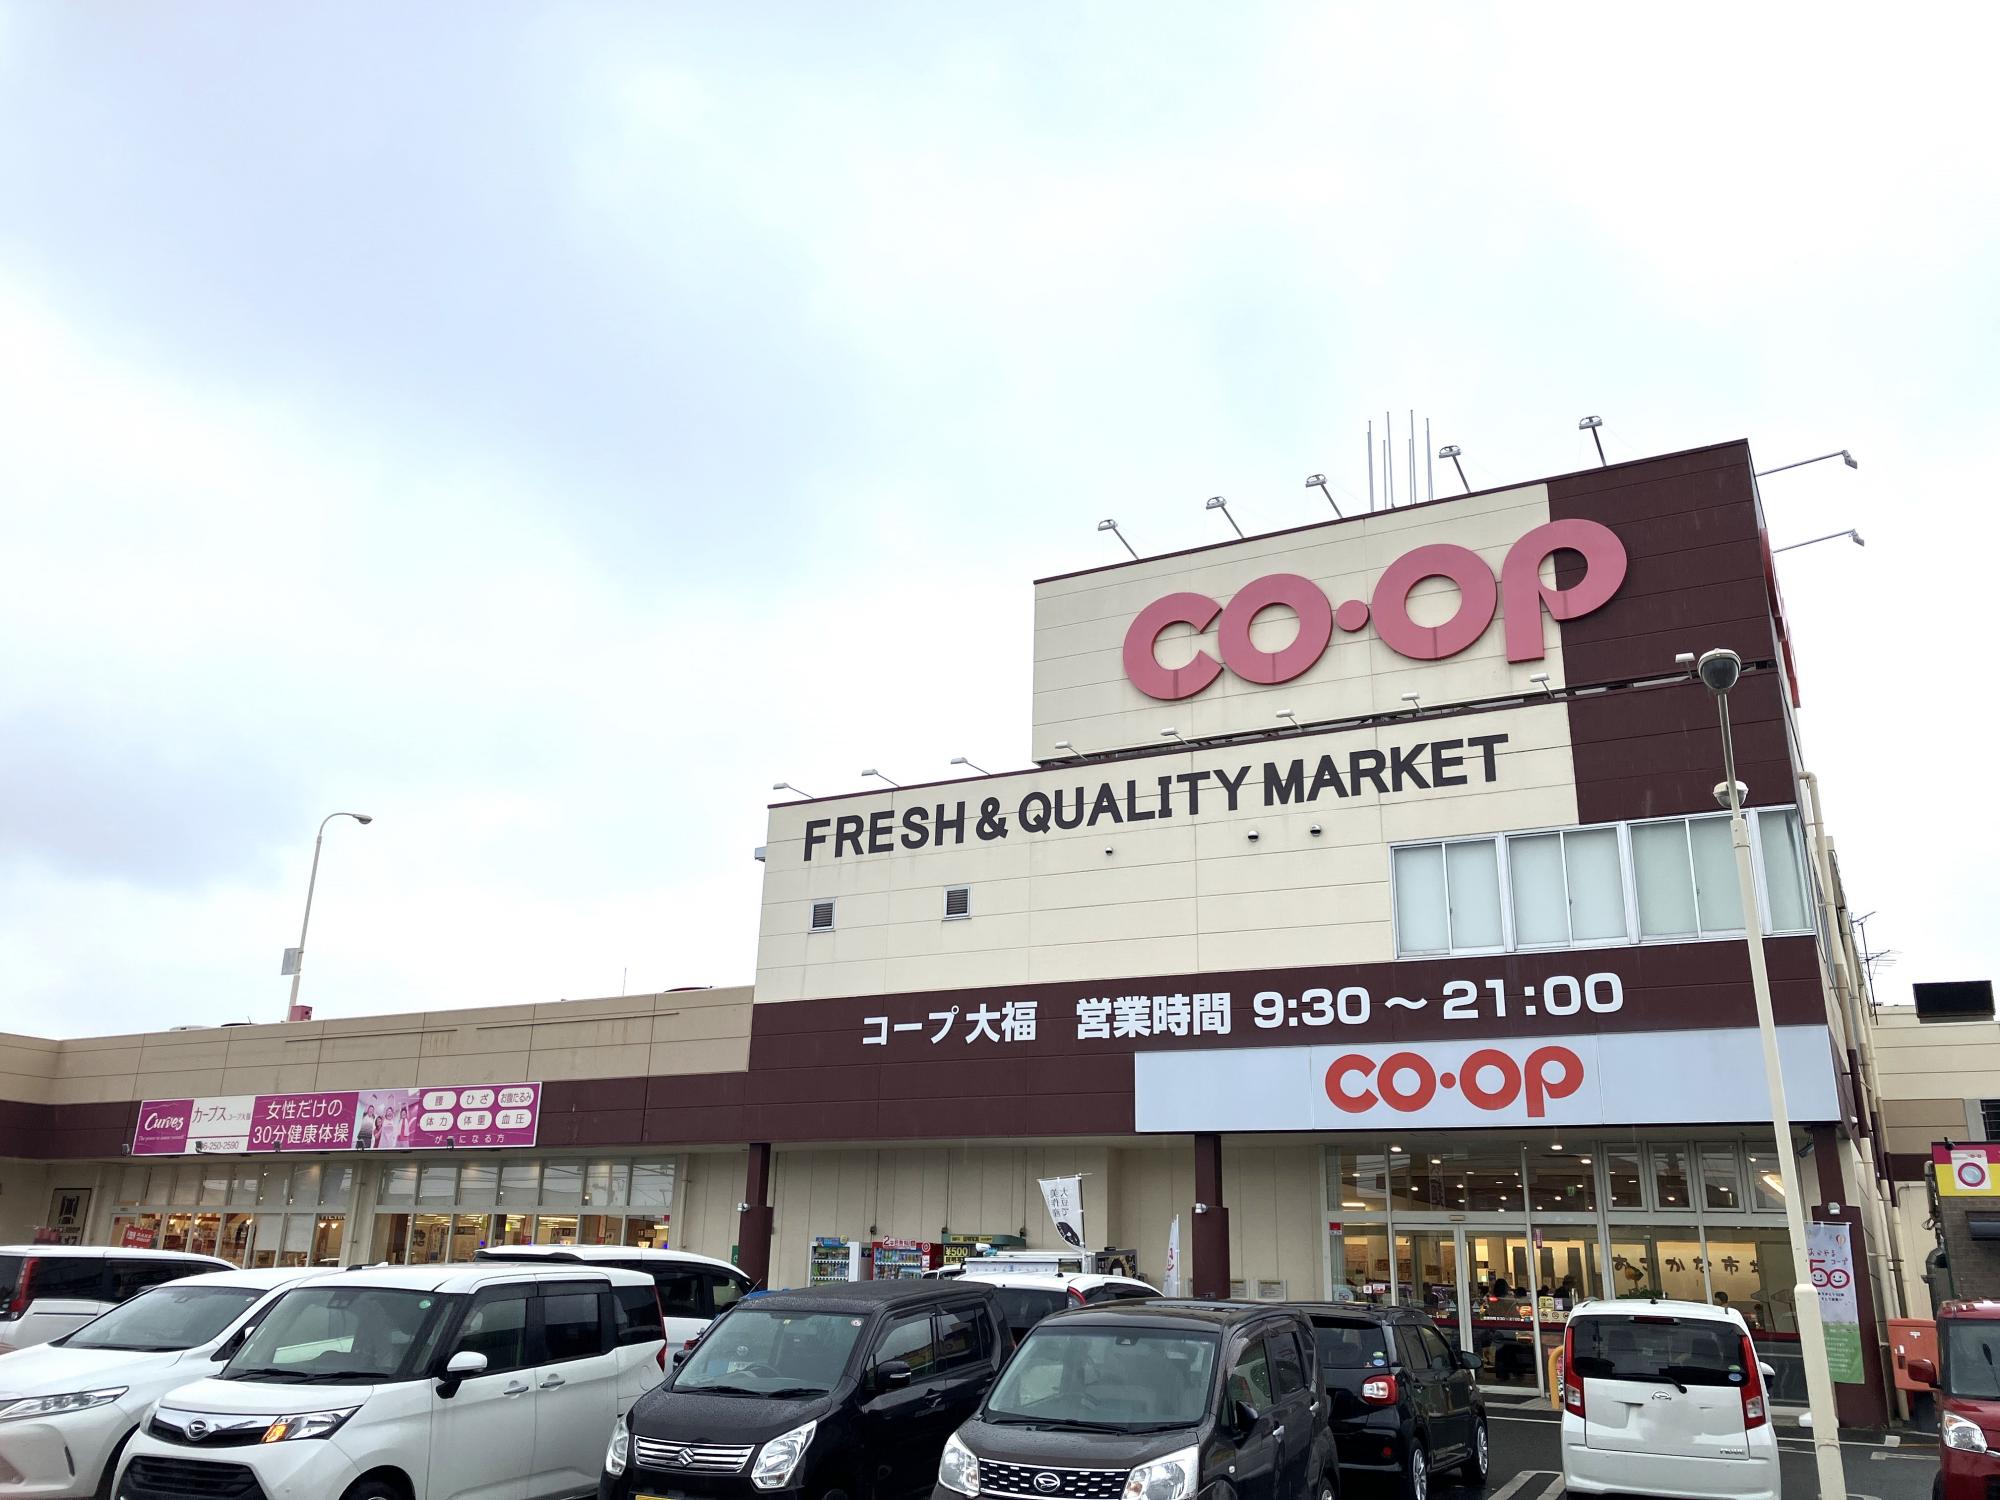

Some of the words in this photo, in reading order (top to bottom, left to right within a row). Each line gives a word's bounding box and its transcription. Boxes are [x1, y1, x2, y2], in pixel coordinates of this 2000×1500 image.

[803, 799, 966, 861] FRESH
[976, 796, 1009, 840] &
[1017, 765, 1252, 835] QUALITY
[1262, 733, 1509, 807] MARKET
[862, 1001, 1037, 1046] コープ大福
[1076, 992, 1232, 1040] 営業時間
[1252, 985, 1371, 1029] 9:30
[1442, 972, 1625, 1021] 21:00
[466, 1093, 490, 1105] ひざ
[266, 1098, 343, 1121] 女性だけの
[144, 1112, 184, 1131] Curves
[425, 1116, 448, 1127] 体力
[463, 1114, 486, 1126] 体重
[501, 1113, 529, 1125] 血圧
[253, 1123, 350, 1145] 30分健康体操
[434, 1134, 505, 1145] がになる方
[945, 1246, 968, 1256] ¥500
